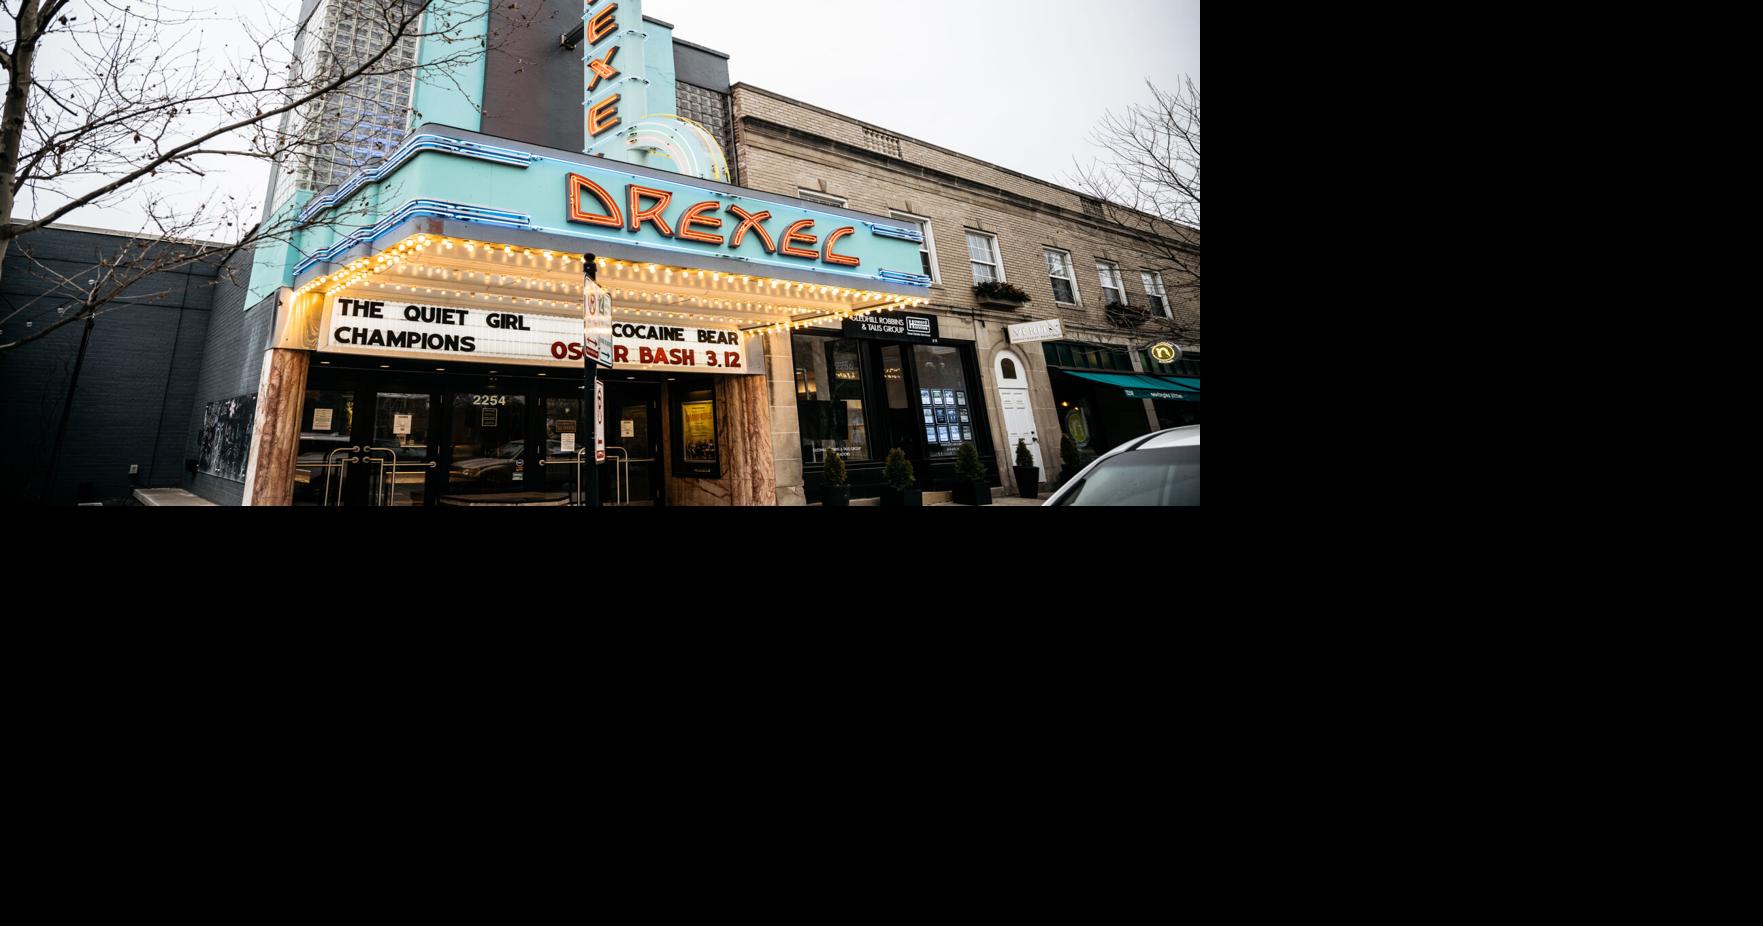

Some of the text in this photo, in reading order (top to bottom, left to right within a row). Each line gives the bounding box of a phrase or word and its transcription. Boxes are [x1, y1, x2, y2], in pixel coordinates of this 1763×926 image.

[338, 298, 384, 318] THE
[403, 305, 469, 325] QUIET
[485, 312, 531, 331] GIRL
[612, 323, 685, 341] COCAINE
[697, 329, 739, 345] BEAR
[883, 325, 905, 334] GROUP
[334, 326, 476, 352] CHAMPIONS
[551, 341, 629, 363] OSR
[639, 347, 695, 366] BASH
[705, 350, 741, 368] 3.12
[473, 395, 506, 406] 2254
